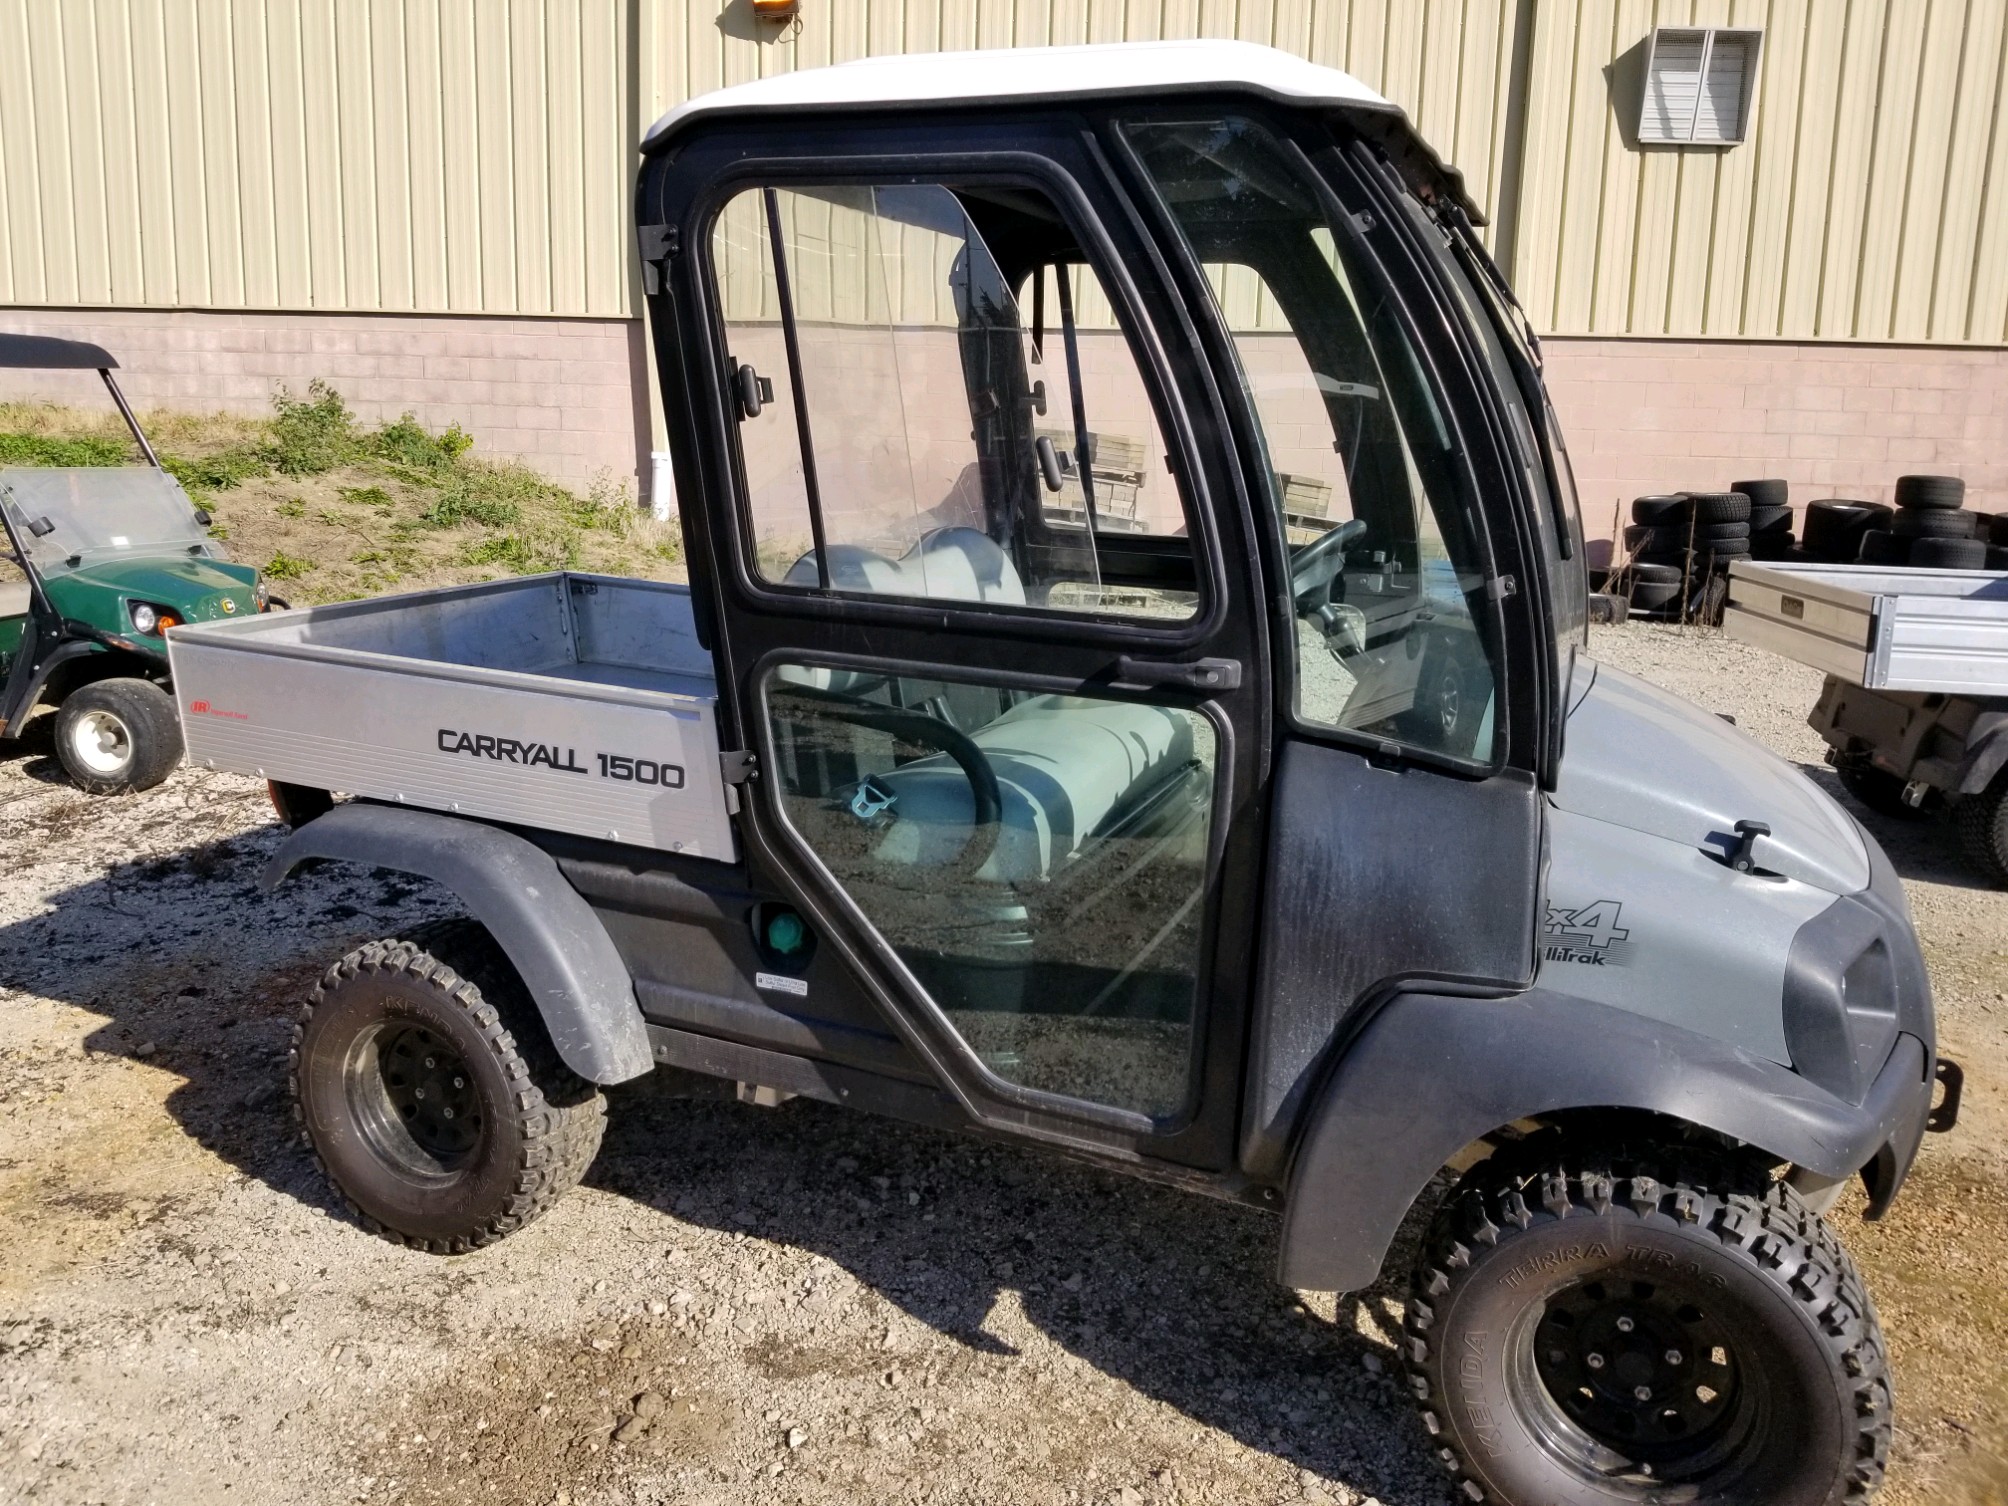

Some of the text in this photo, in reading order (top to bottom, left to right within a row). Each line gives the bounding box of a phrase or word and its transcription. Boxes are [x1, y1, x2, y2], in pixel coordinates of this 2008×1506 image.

[438, 729, 685, 789] CARRYALL 1500
[1544, 899, 1629, 949] x4
[1543, 946, 1606, 966] lliTrak
[1499, 1243, 1611, 1289] TERRA
